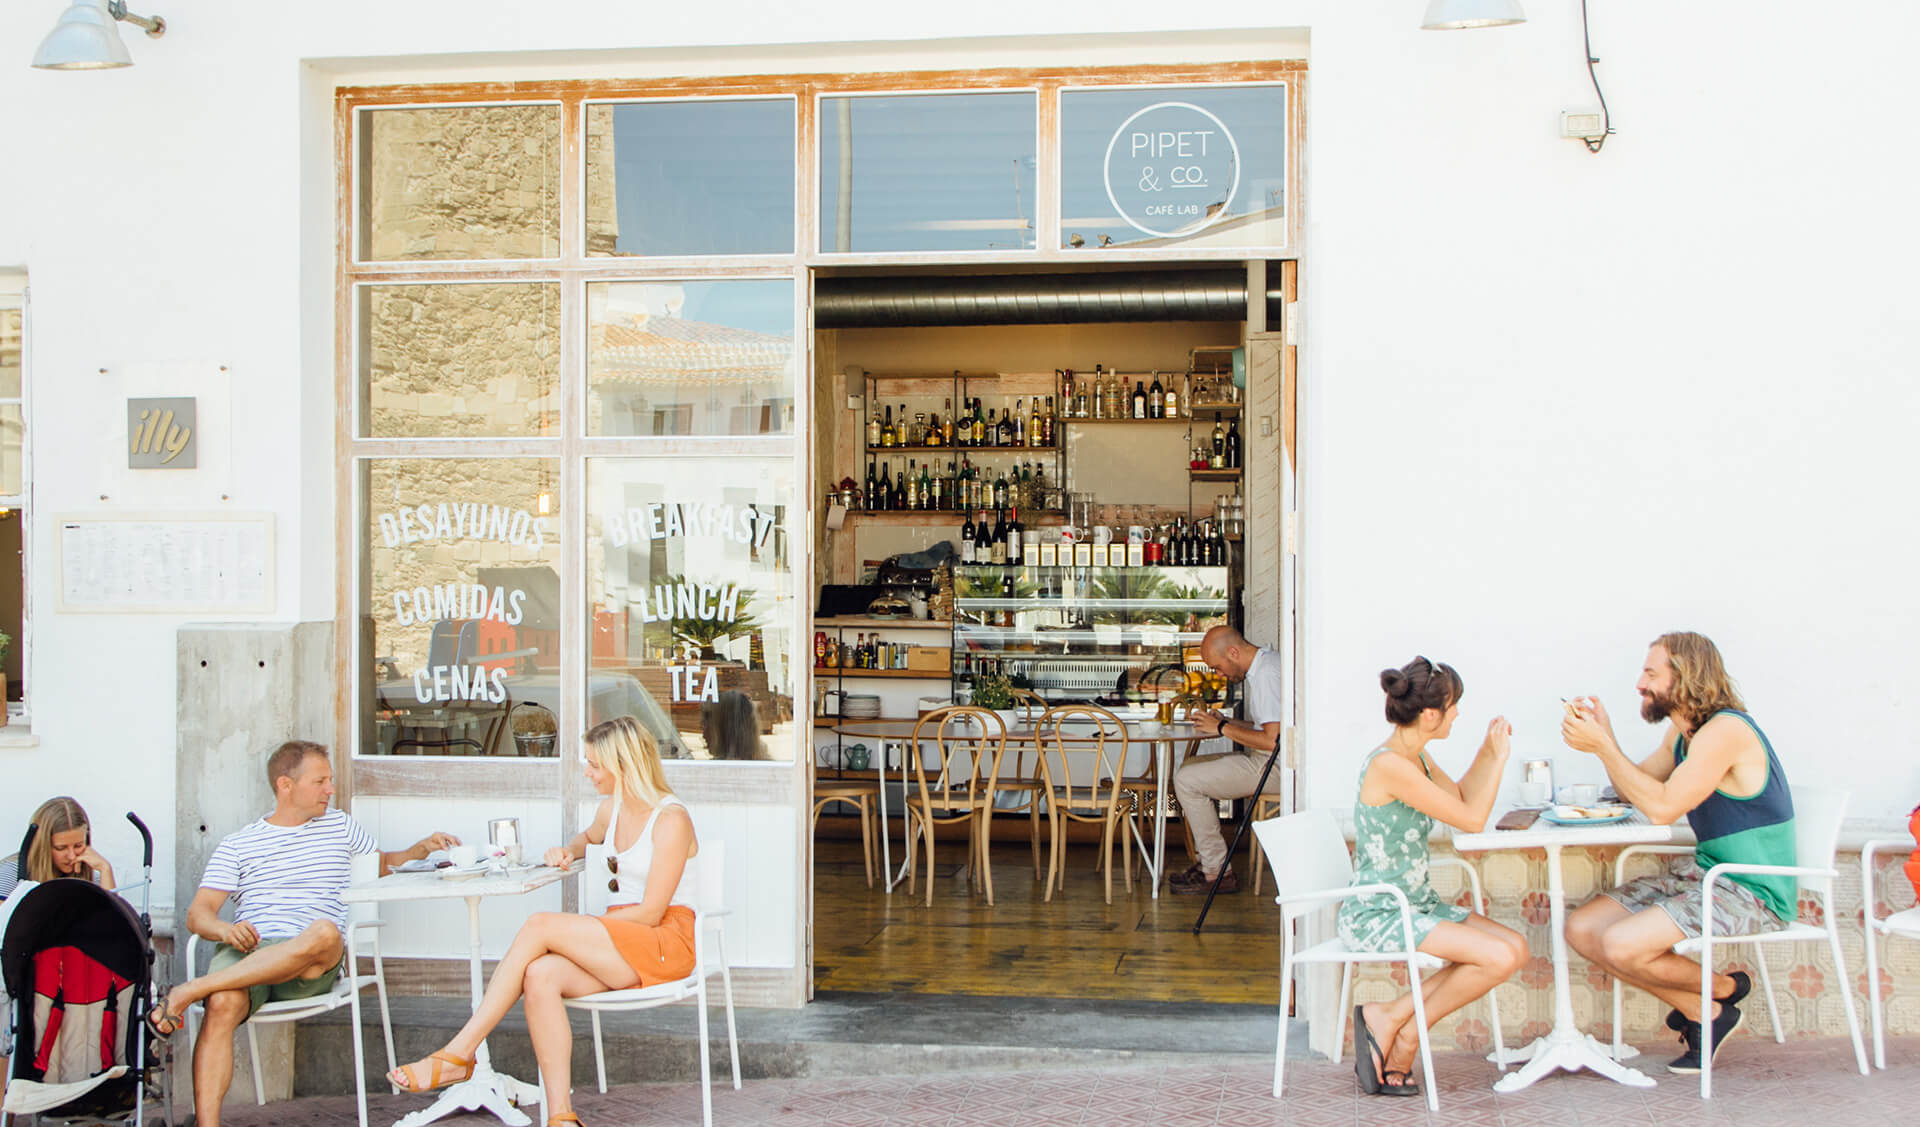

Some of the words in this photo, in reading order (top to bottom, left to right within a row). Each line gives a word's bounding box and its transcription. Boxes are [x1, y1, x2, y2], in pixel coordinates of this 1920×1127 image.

[1132, 131, 1215, 158] PIPET
[1138, 166, 1163, 192] &
[1170, 166, 1209, 187] CO.
[1145, 204, 1174, 216] CAFÉ
[1177, 204, 1199, 216] LAB
[131, 408, 191, 465] illy
[378, 502, 550, 552] DESAYUNOS
[607, 502, 776, 548] BREAKFAST
[393, 583, 526, 627] COMIDAS
[640, 582, 740, 624] LUNCH
[413, 664, 507, 704] CENAS
[666, 665, 720, 704] TEA
